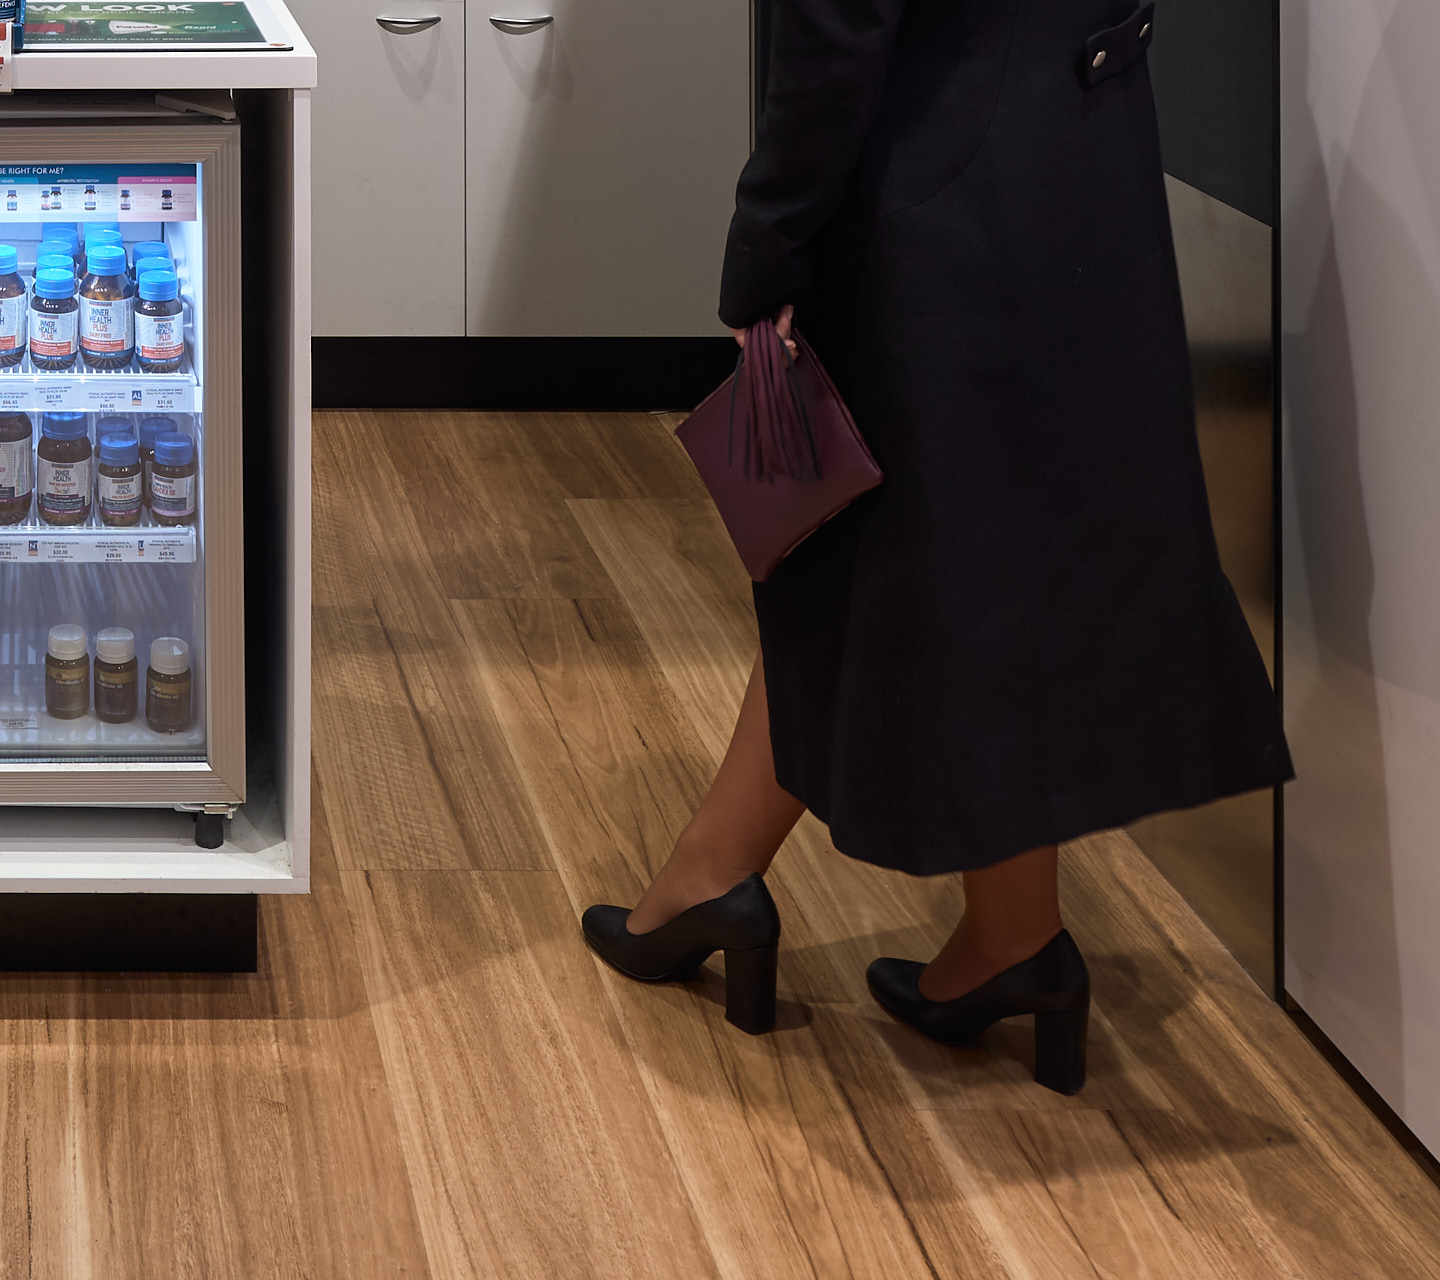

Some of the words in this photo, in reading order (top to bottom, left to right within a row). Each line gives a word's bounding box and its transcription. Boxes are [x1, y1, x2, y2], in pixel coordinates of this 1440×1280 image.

[8, 167, 31, 175] RIGHT
[33, 167, 47, 175] FOR
[48, 167, 64, 175] ME?
